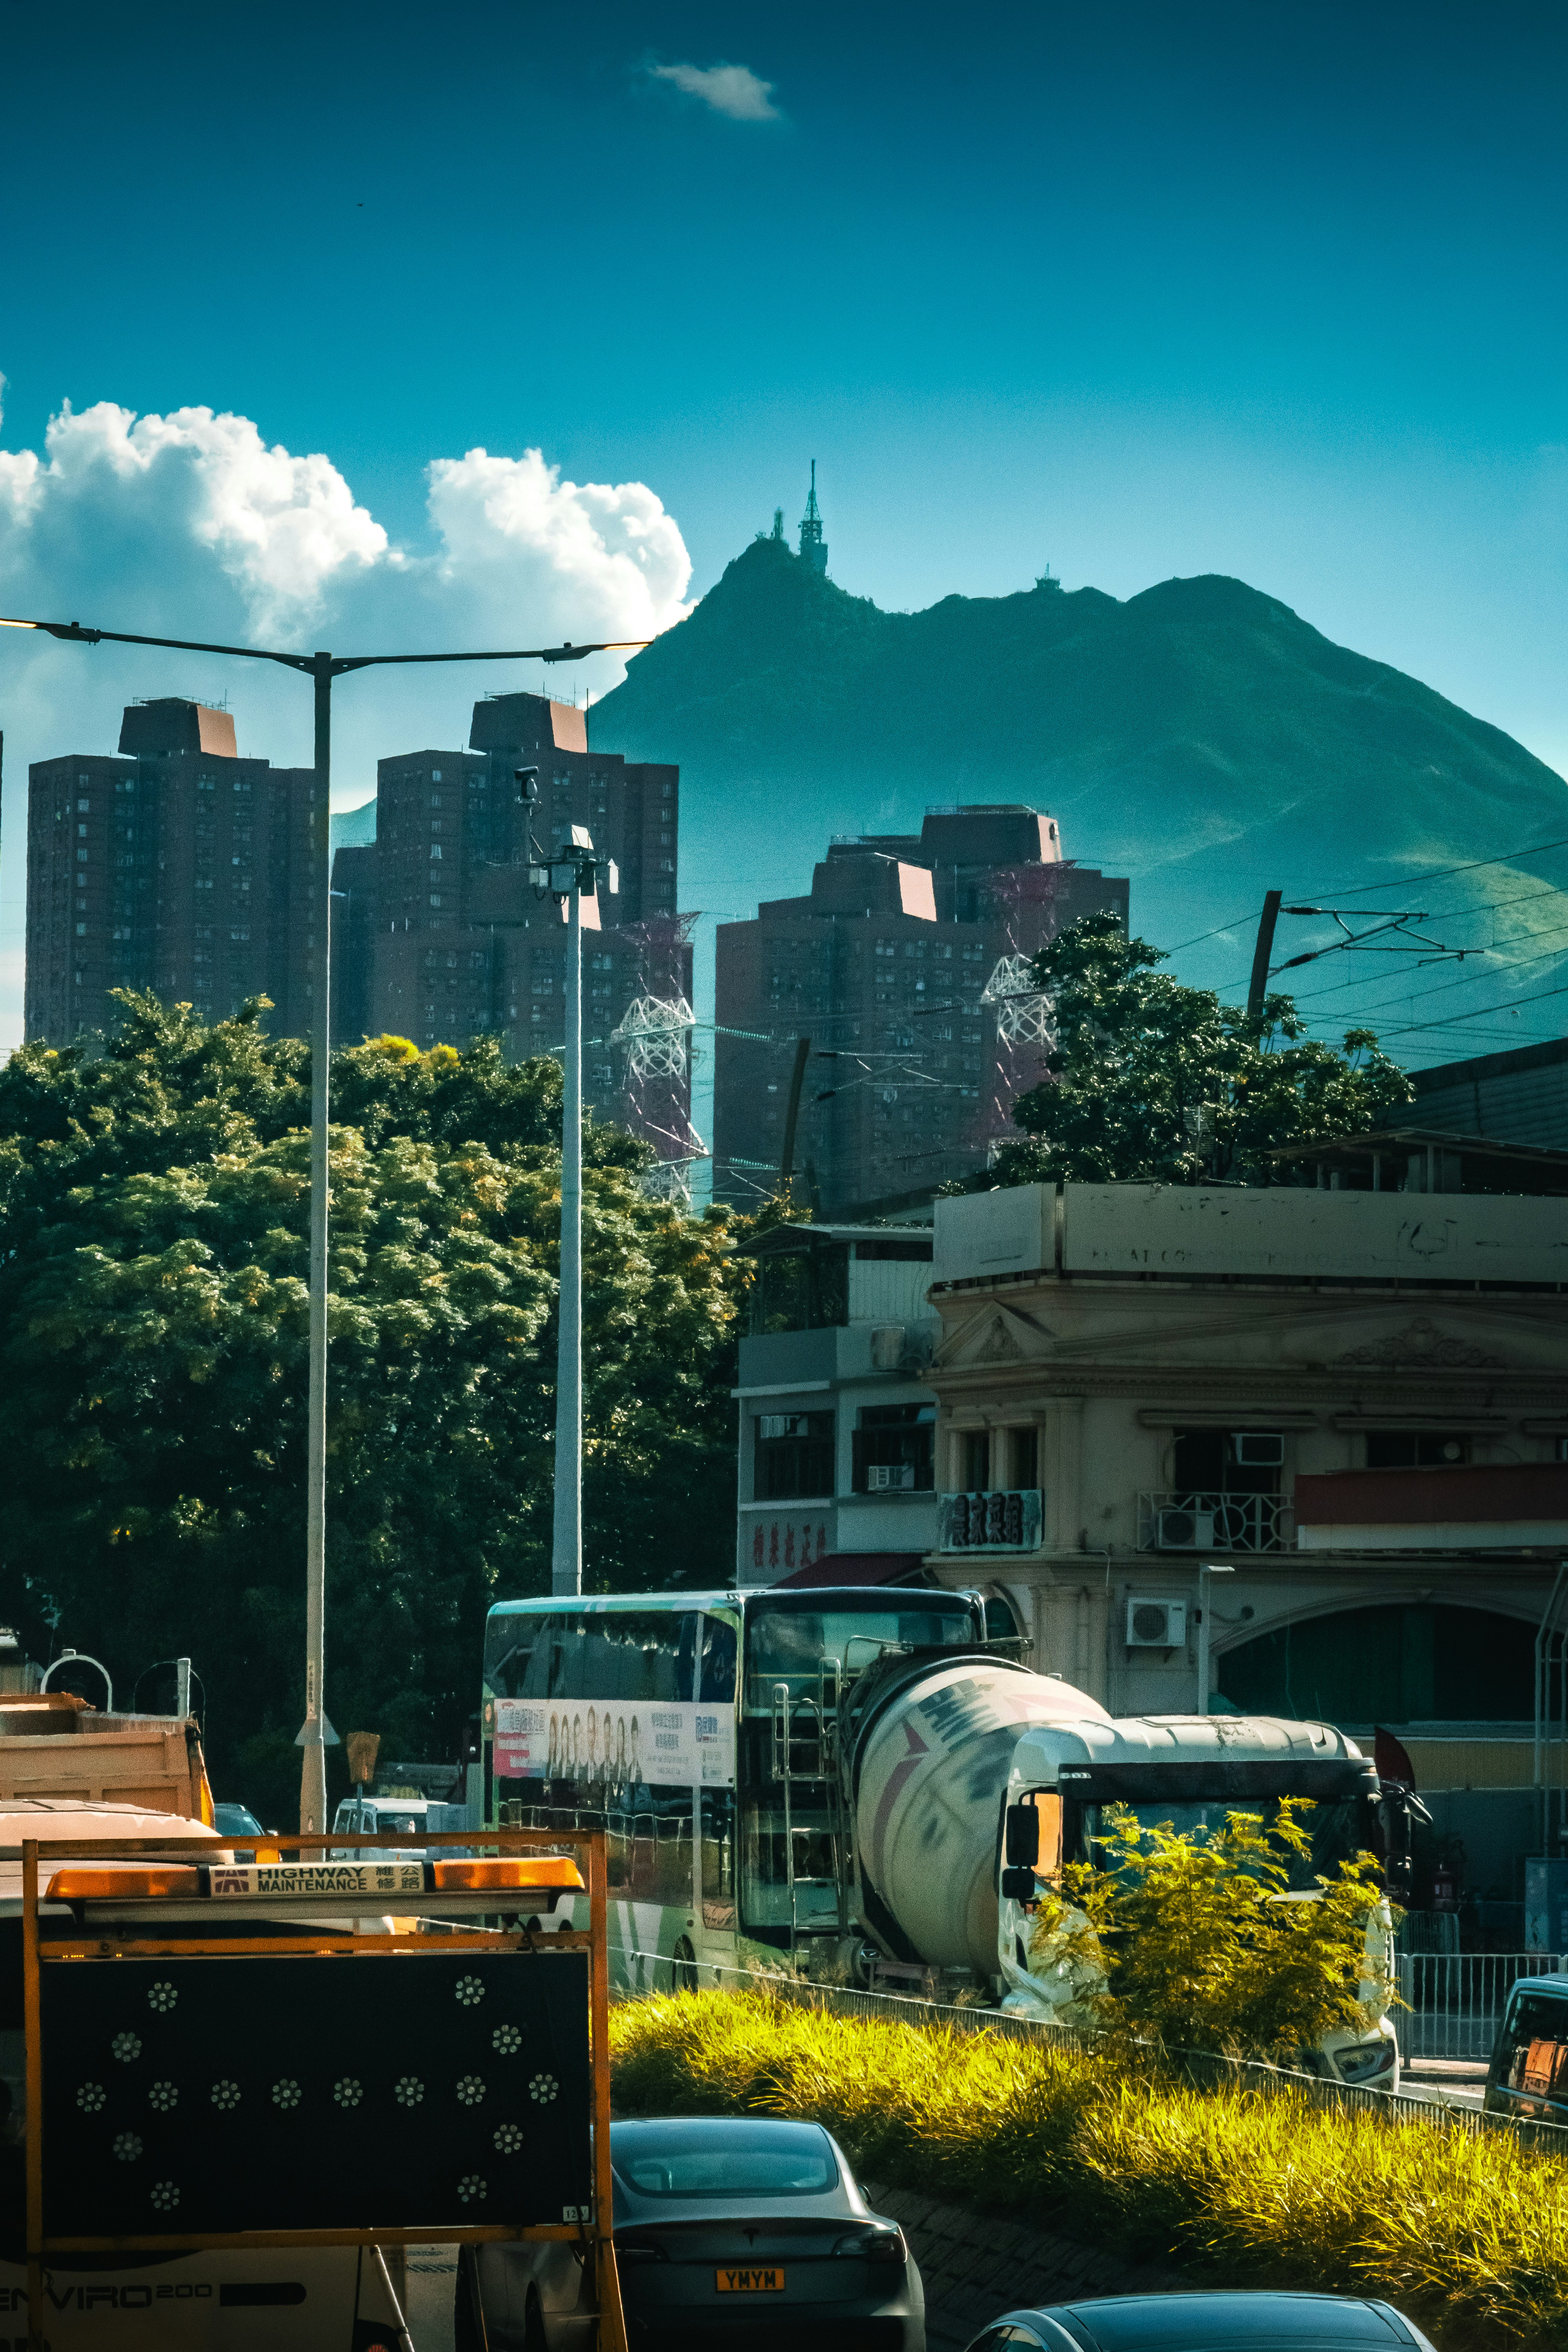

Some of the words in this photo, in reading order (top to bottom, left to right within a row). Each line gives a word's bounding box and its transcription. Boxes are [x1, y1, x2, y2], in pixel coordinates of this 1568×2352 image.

[258, 1867, 365, 1879] HIGHWAY
[258, 1878, 367, 1892] MAINTENANCE
[726, 2271, 775, 2288] YMYM
